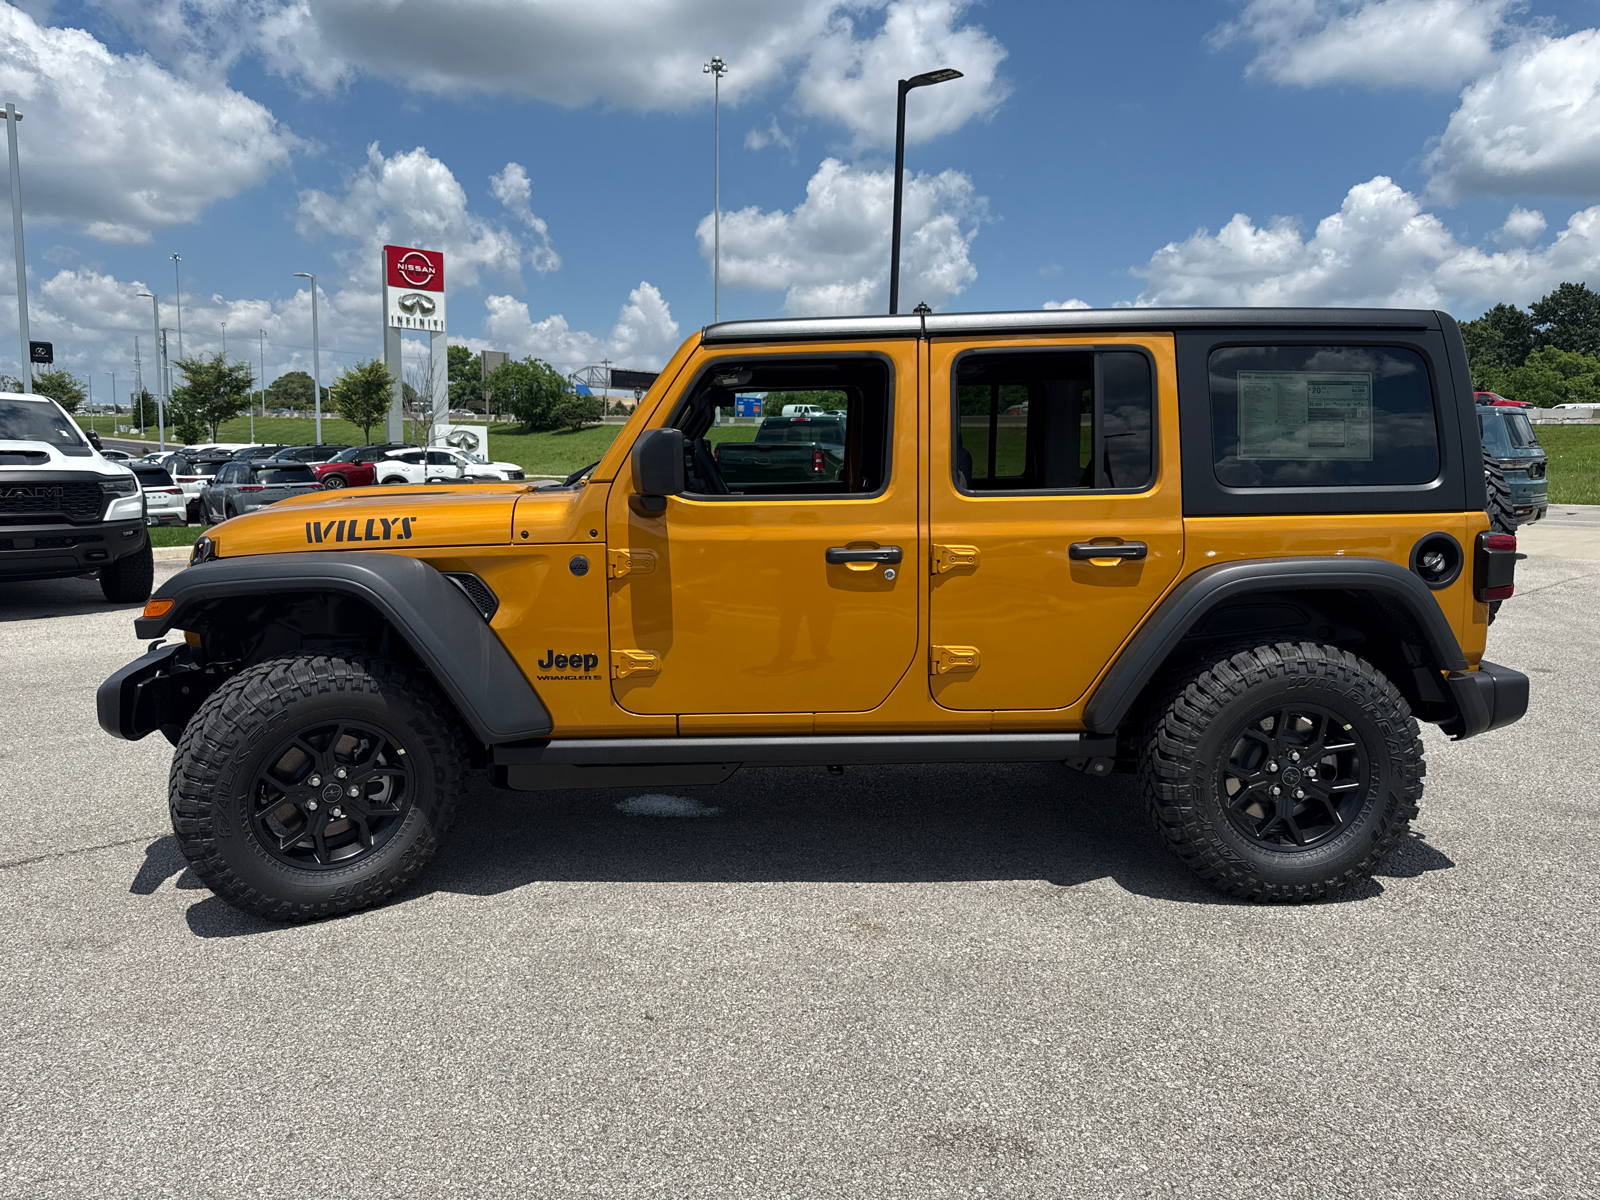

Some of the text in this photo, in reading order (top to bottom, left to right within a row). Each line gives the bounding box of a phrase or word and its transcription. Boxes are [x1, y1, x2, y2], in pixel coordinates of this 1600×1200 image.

[397, 263, 436, 274] NISSAN
[391, 312, 444, 331] INFINITI
[0, 487, 63, 497] AM
[306, 517, 417, 543] WILLYS
[538, 649, 599, 672] Jeep
[1286, 676, 1403, 780] WILDPEAK
[1193, 759, 1260, 874] FALKEN
